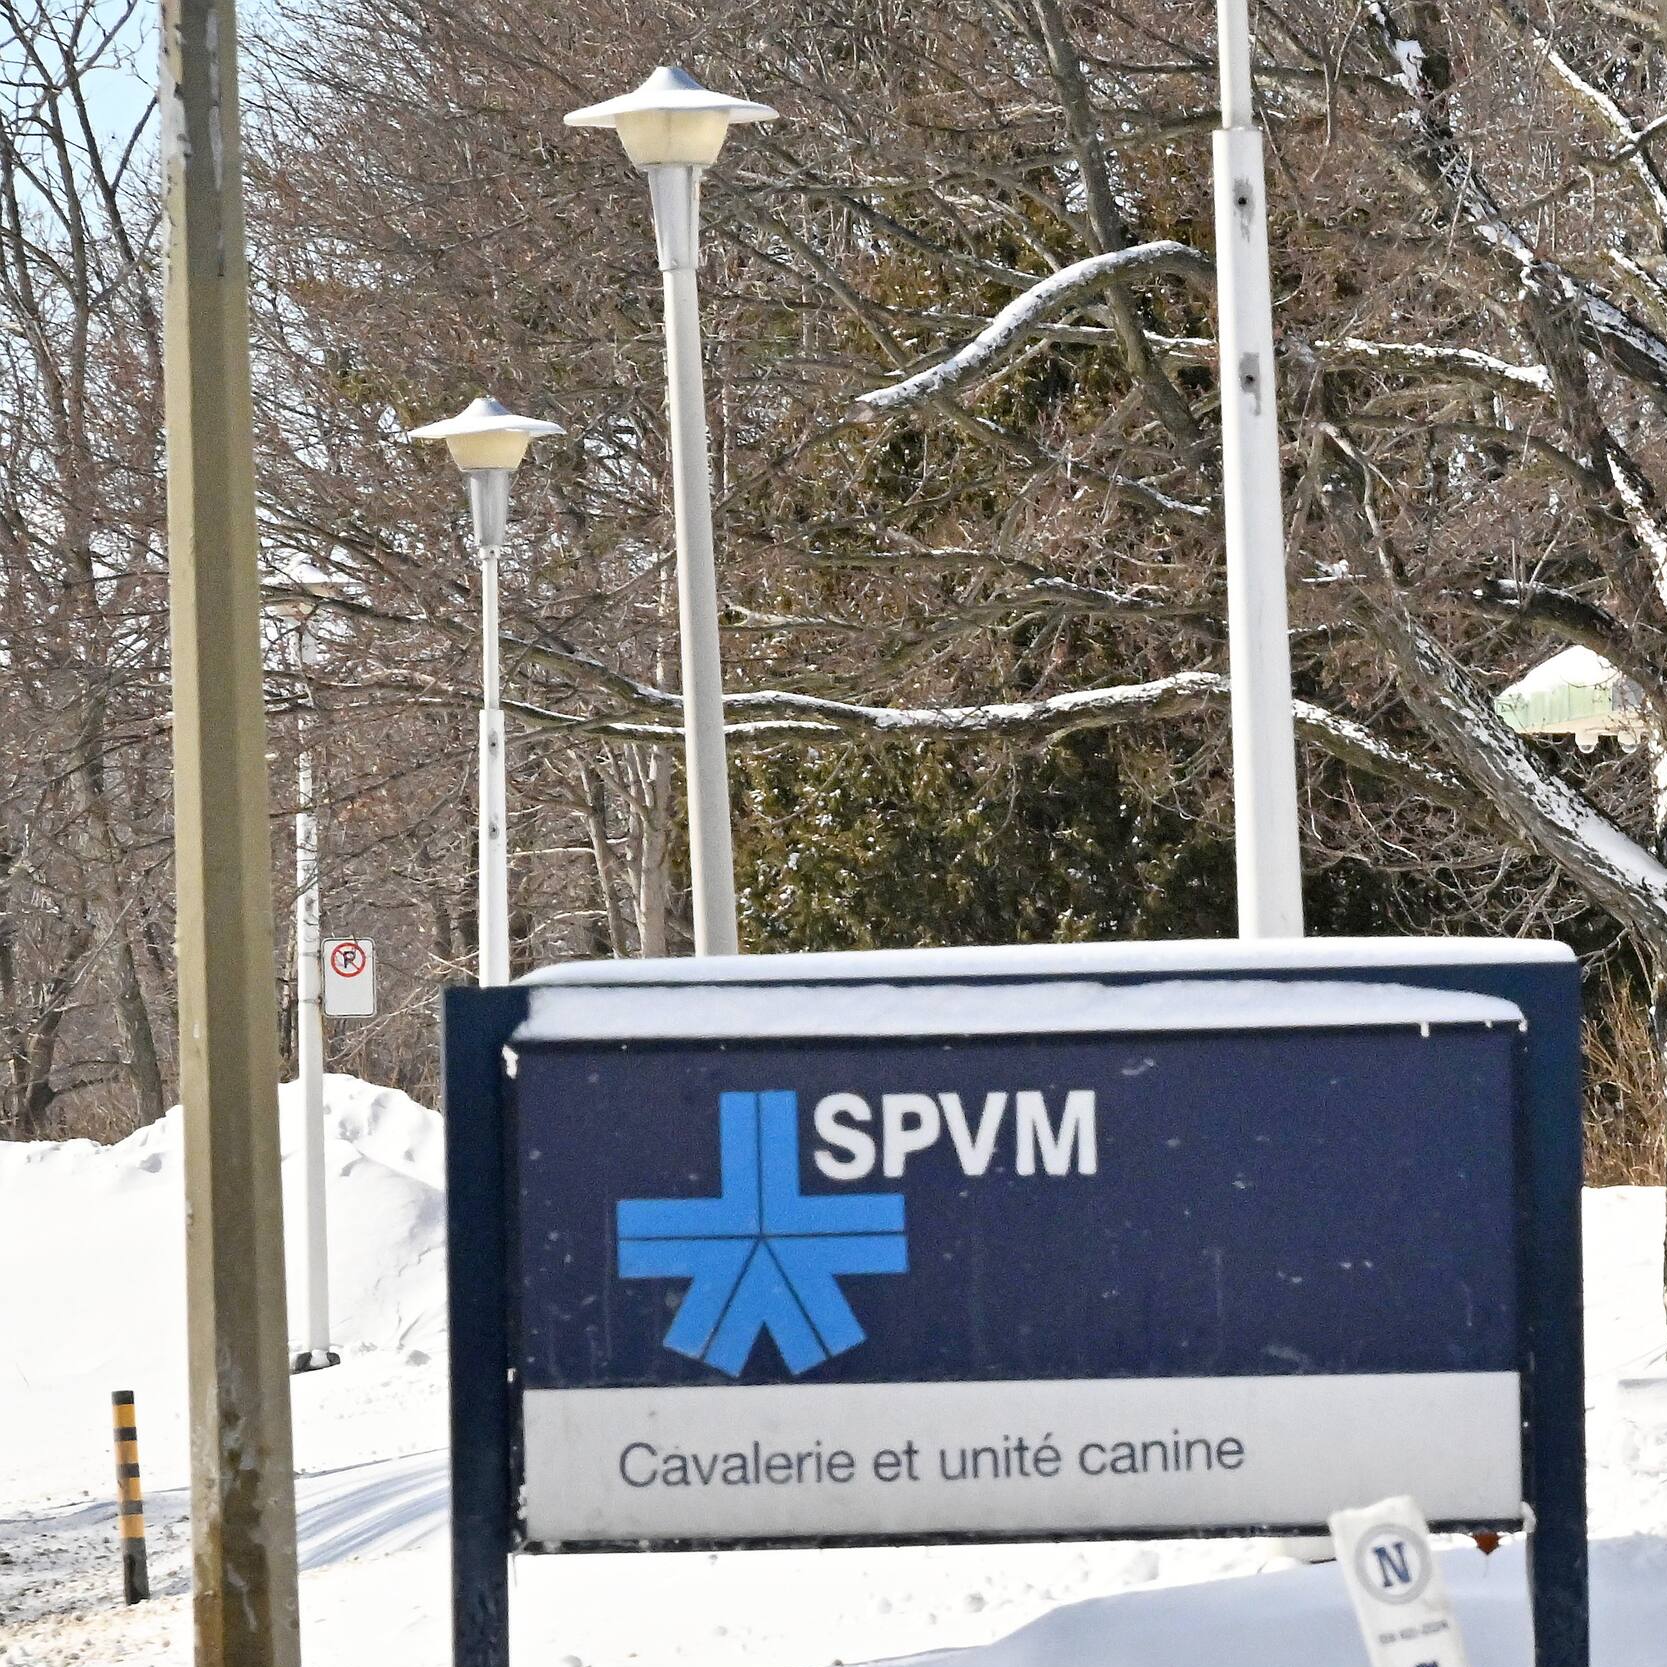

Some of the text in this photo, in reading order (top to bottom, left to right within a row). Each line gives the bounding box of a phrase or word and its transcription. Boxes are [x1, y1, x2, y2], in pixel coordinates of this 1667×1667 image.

[343, 951, 356, 969] P
[813, 1089, 1098, 1181] SPVM
[618, 1428, 1245, 1488] Cavalerie et unité canine
[1371, 1541, 1411, 1588] N
